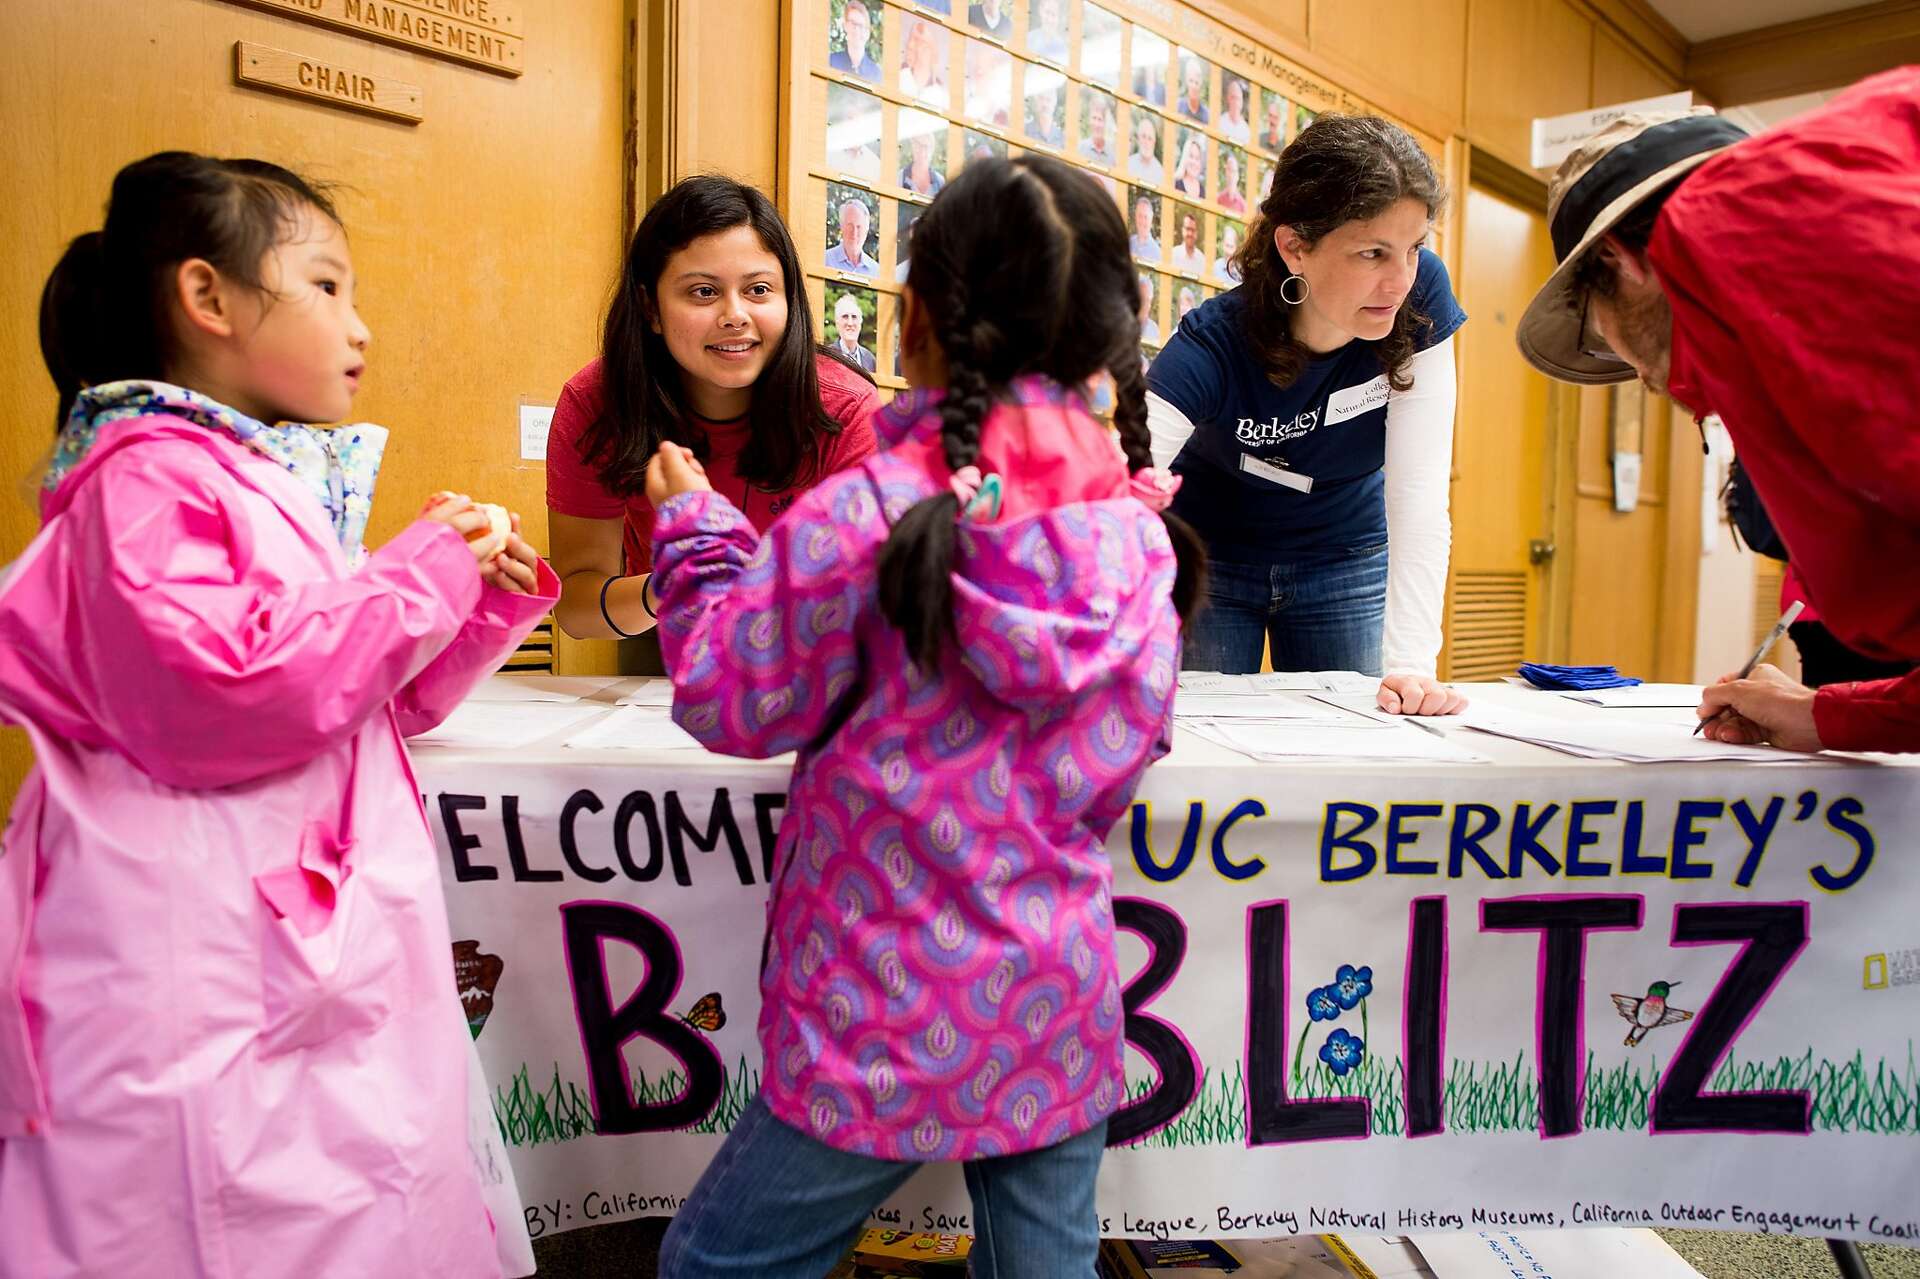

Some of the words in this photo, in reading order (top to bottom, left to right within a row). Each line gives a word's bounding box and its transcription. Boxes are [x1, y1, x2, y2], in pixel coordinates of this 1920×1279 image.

[344, 0, 506, 62] MANAGEMENT
[298, 61, 376, 103] CHAIR
[1235, 406, 1322, 440] Berkeley
[1130, 799, 1268, 883] UC
[1319, 789, 1877, 895] BERKELEY'S
[524, 1199, 572, 1237] BY:
[923, 1206, 969, 1231] Save
[1123, 1212, 1208, 1241] League,
[1310, 1206, 1386, 1230] Natural
[1398, 1208, 1464, 1230] History
[1472, 1207, 1565, 1229] Museums,
[1572, 1201, 1654, 1224] California
[1661, 1202, 1727, 1222] Outdoor
[1732, 1205, 1861, 1232] Engagement
